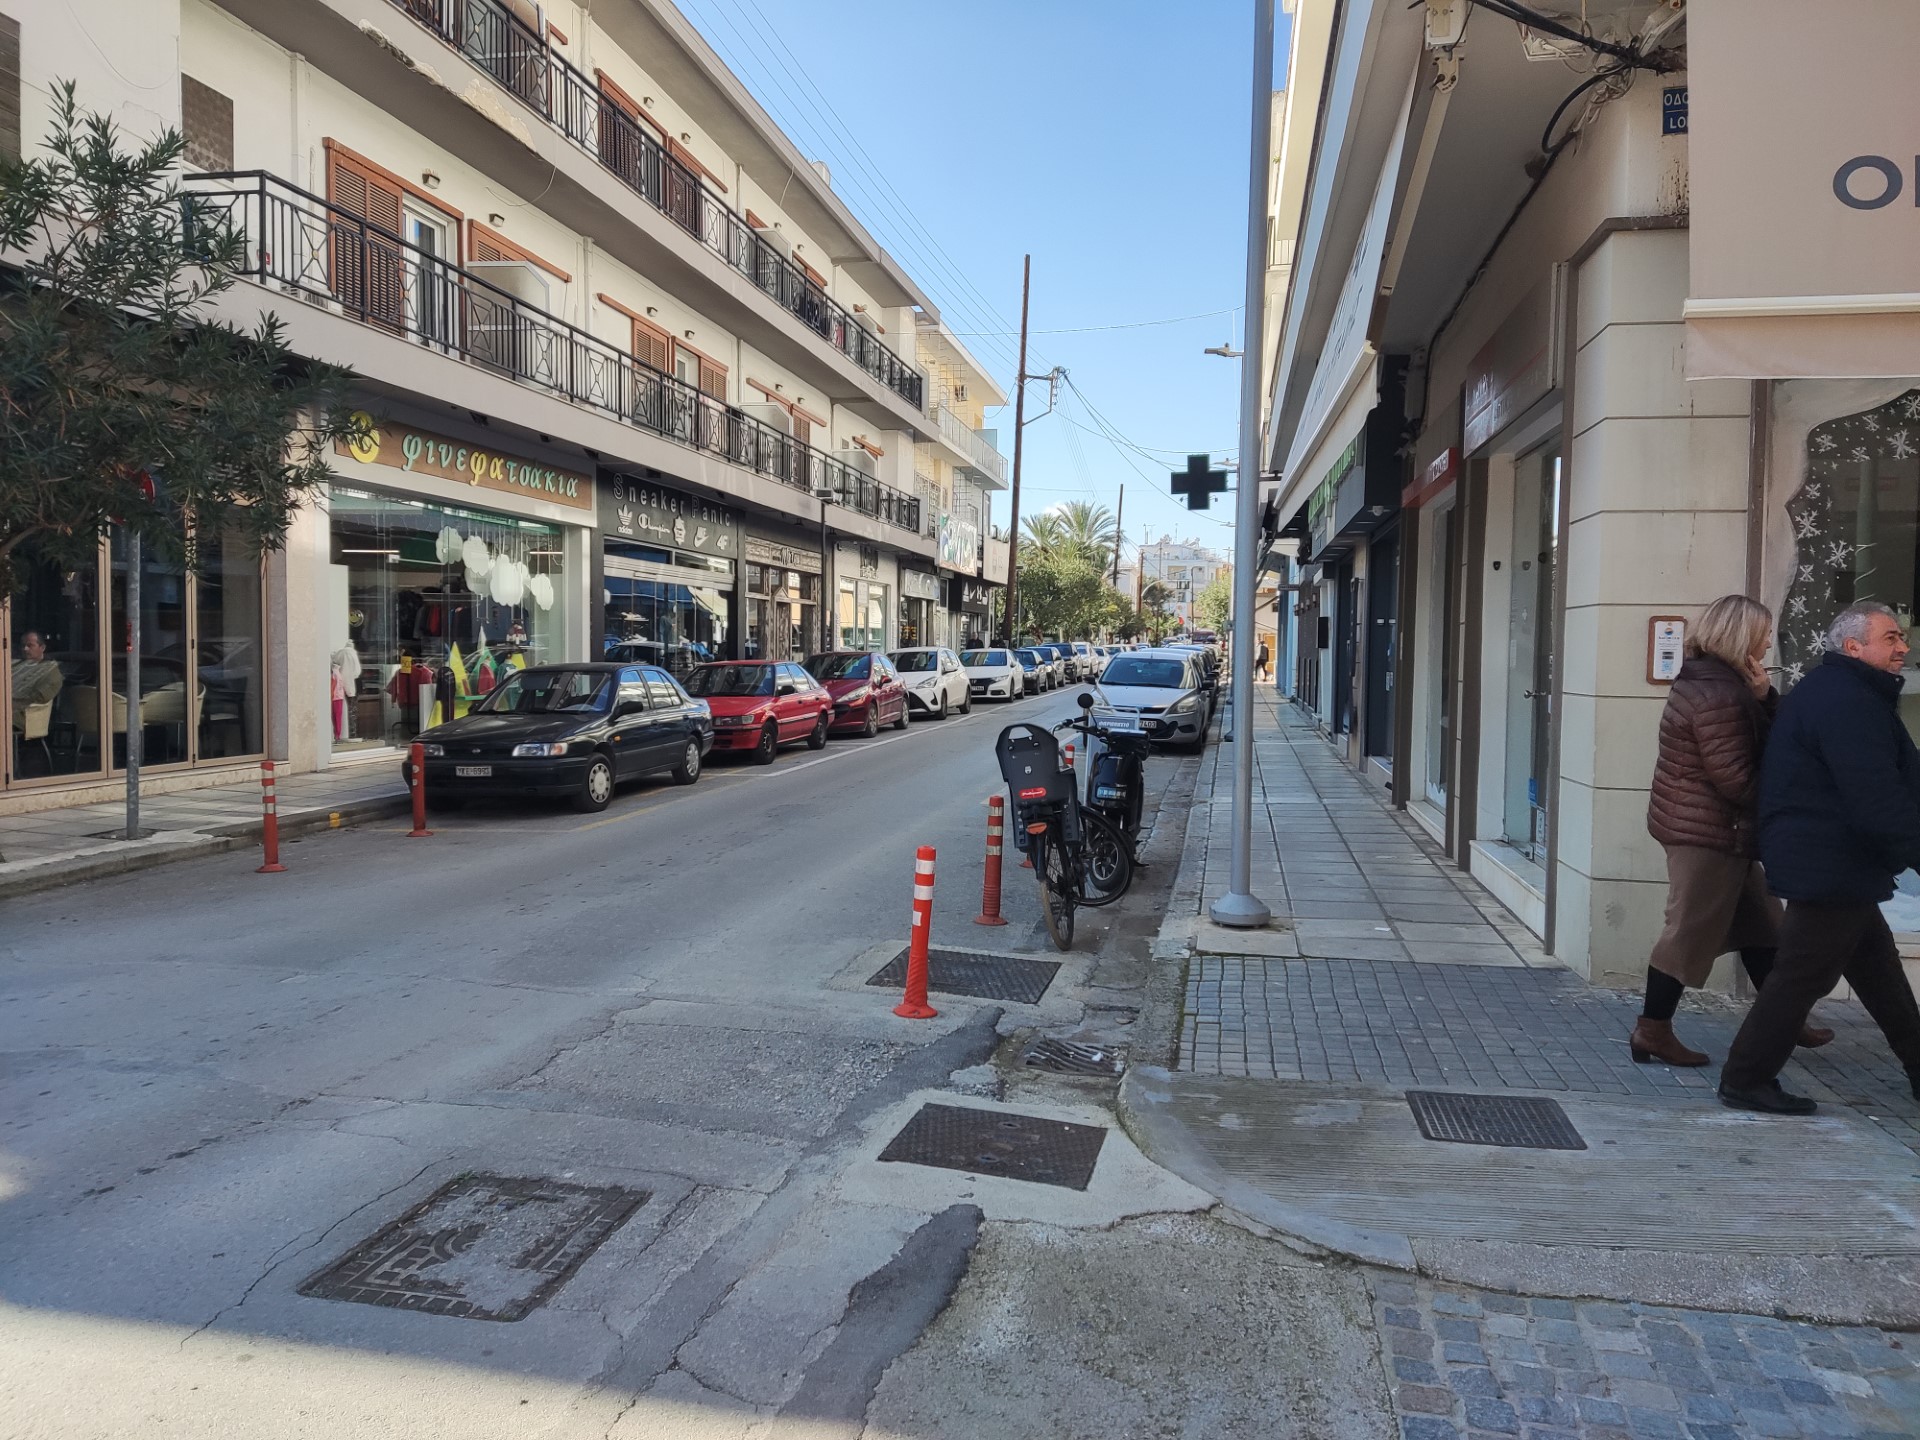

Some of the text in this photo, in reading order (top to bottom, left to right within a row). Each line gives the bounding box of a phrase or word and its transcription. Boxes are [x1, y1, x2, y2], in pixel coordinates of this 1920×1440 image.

[1663, 91, 1688, 106] ΟΔΟ
[1669, 116, 1688, 129] LO
[613, 472, 731, 527] Sneaker Panic
